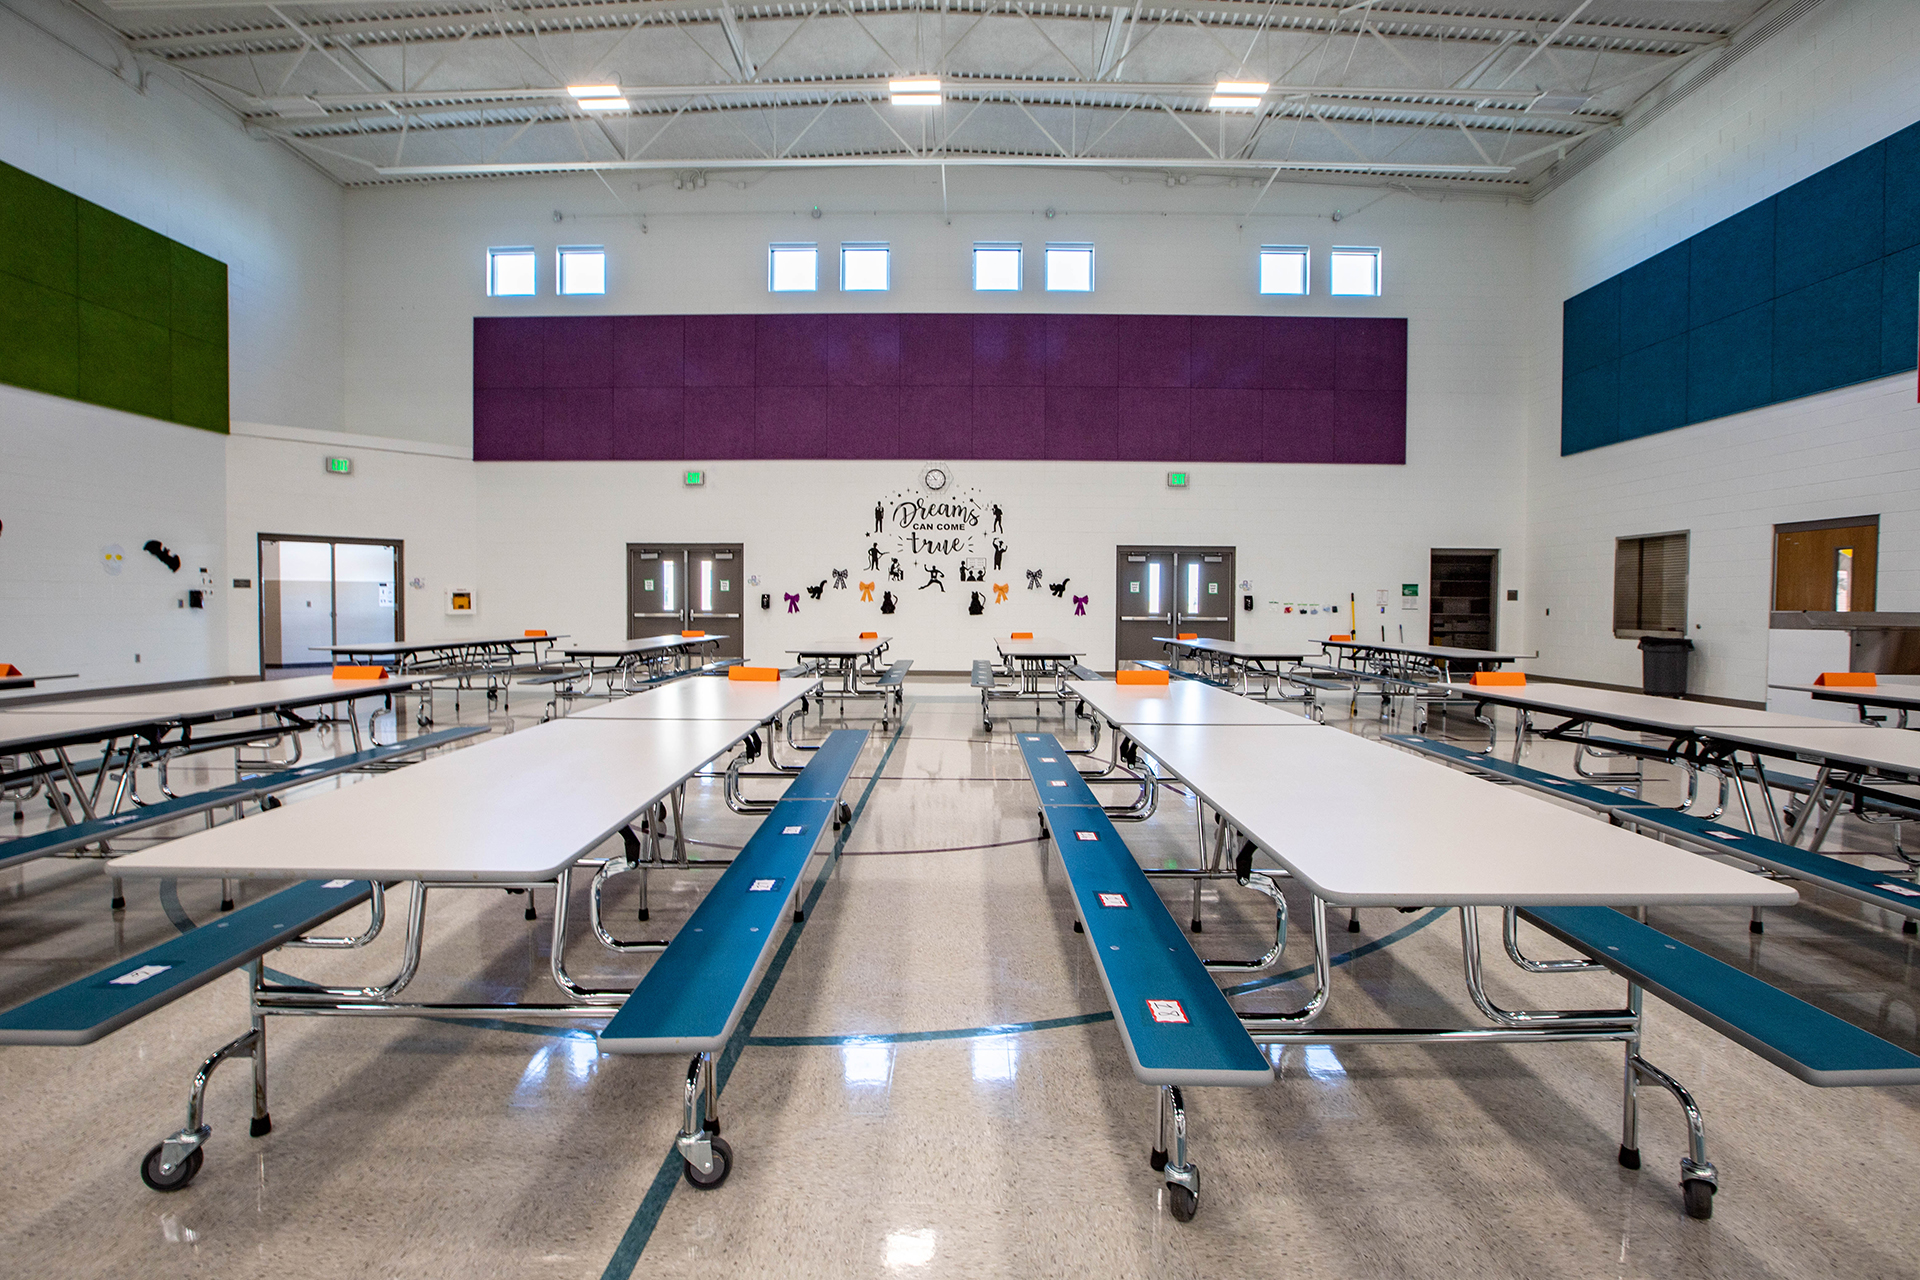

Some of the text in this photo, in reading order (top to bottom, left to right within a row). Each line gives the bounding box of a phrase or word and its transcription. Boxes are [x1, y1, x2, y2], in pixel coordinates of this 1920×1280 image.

[331, 458, 349, 472] EXIT
[687, 472, 701, 484] EXIT
[1171, 473, 1186, 485] EXIT
[892, 498, 980, 528] Dreams
[912, 523, 966, 531] CAN COME
[906, 532, 965, 555] true
